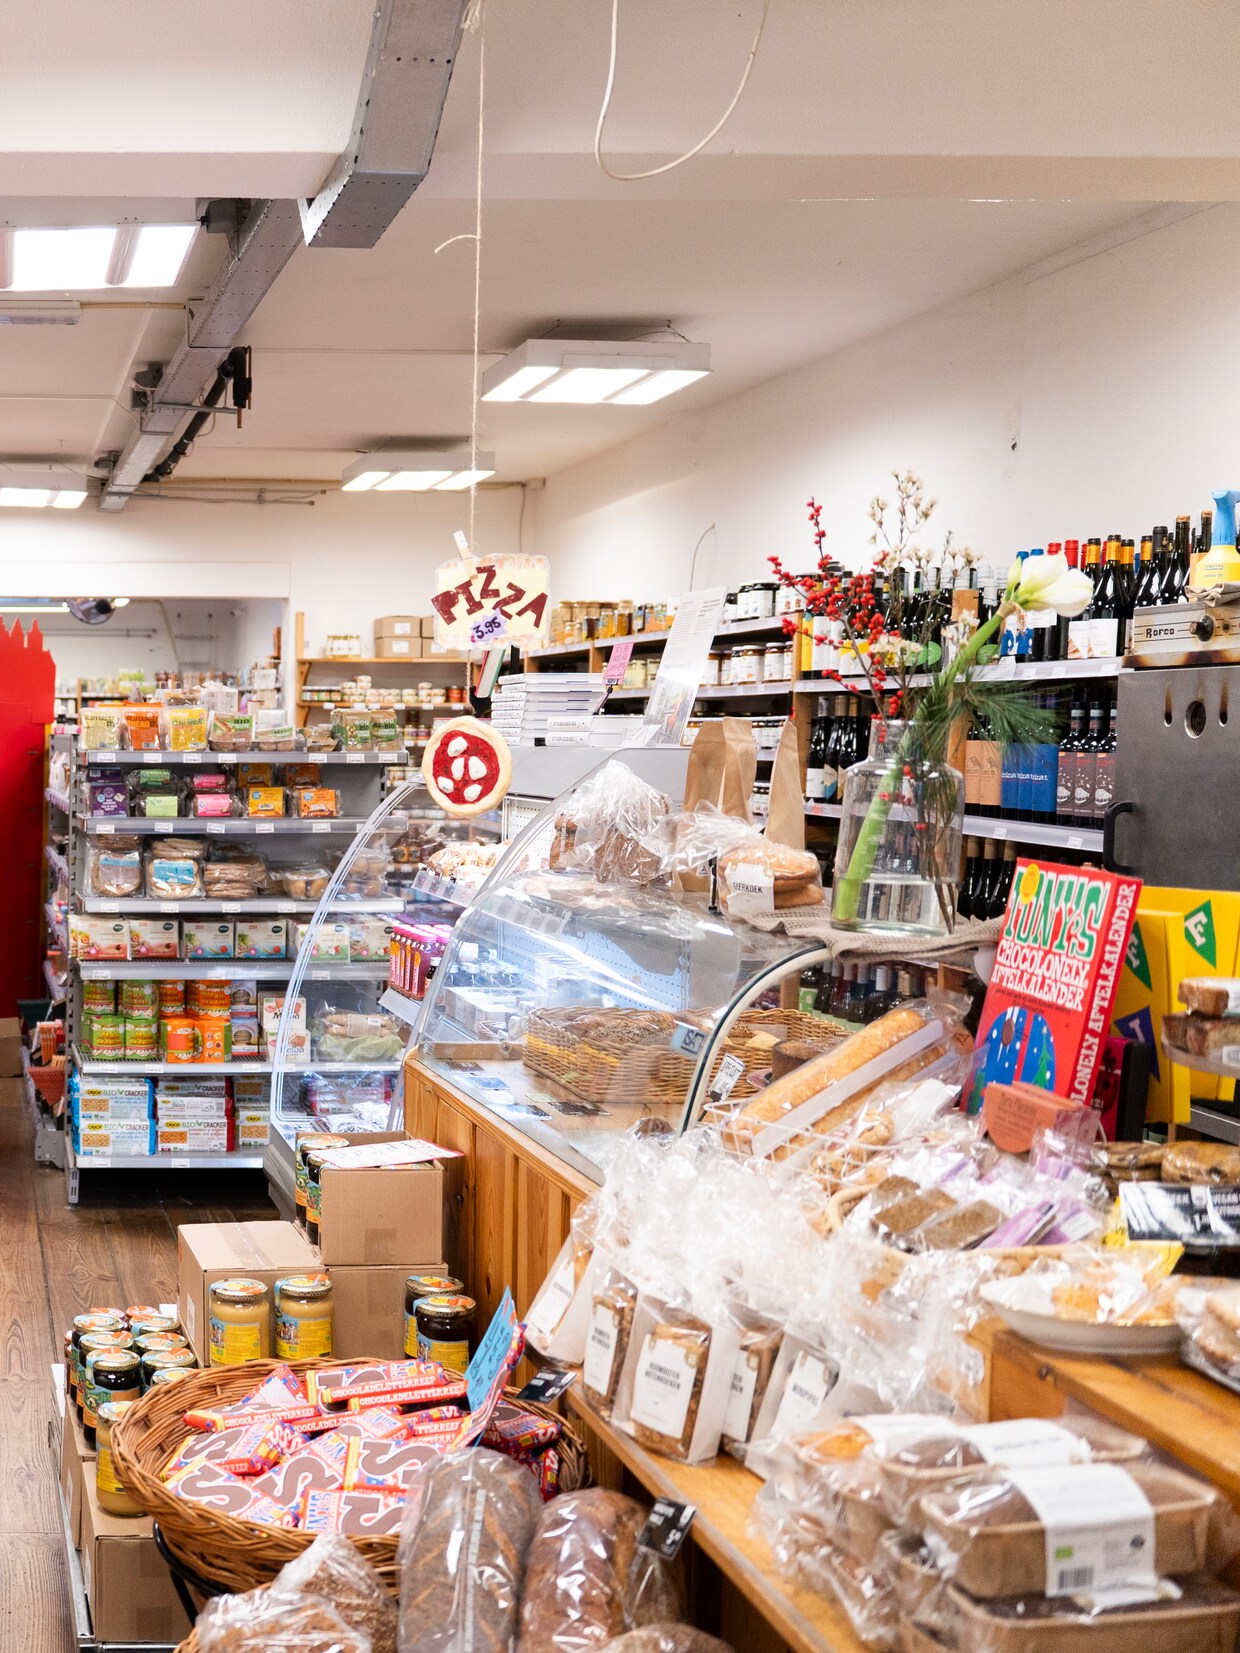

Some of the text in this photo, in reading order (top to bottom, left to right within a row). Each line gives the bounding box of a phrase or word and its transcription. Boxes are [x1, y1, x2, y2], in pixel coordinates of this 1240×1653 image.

[431, 565, 548, 629] PIZZA
[473, 616, 502, 640] 3.95
[1184, 913, 1210, 947] F
[1087, 883, 1137, 1033] AFTELKALENDER
[991, 965, 1085, 1012] AFTELKALENDER
[124, 1089, 148, 1097] CRACKER
[331, 1376, 436, 1398] CHOCOLADELETTERREEP
[225, 1408, 314, 1427] CHOCOLADELETTERREEP
